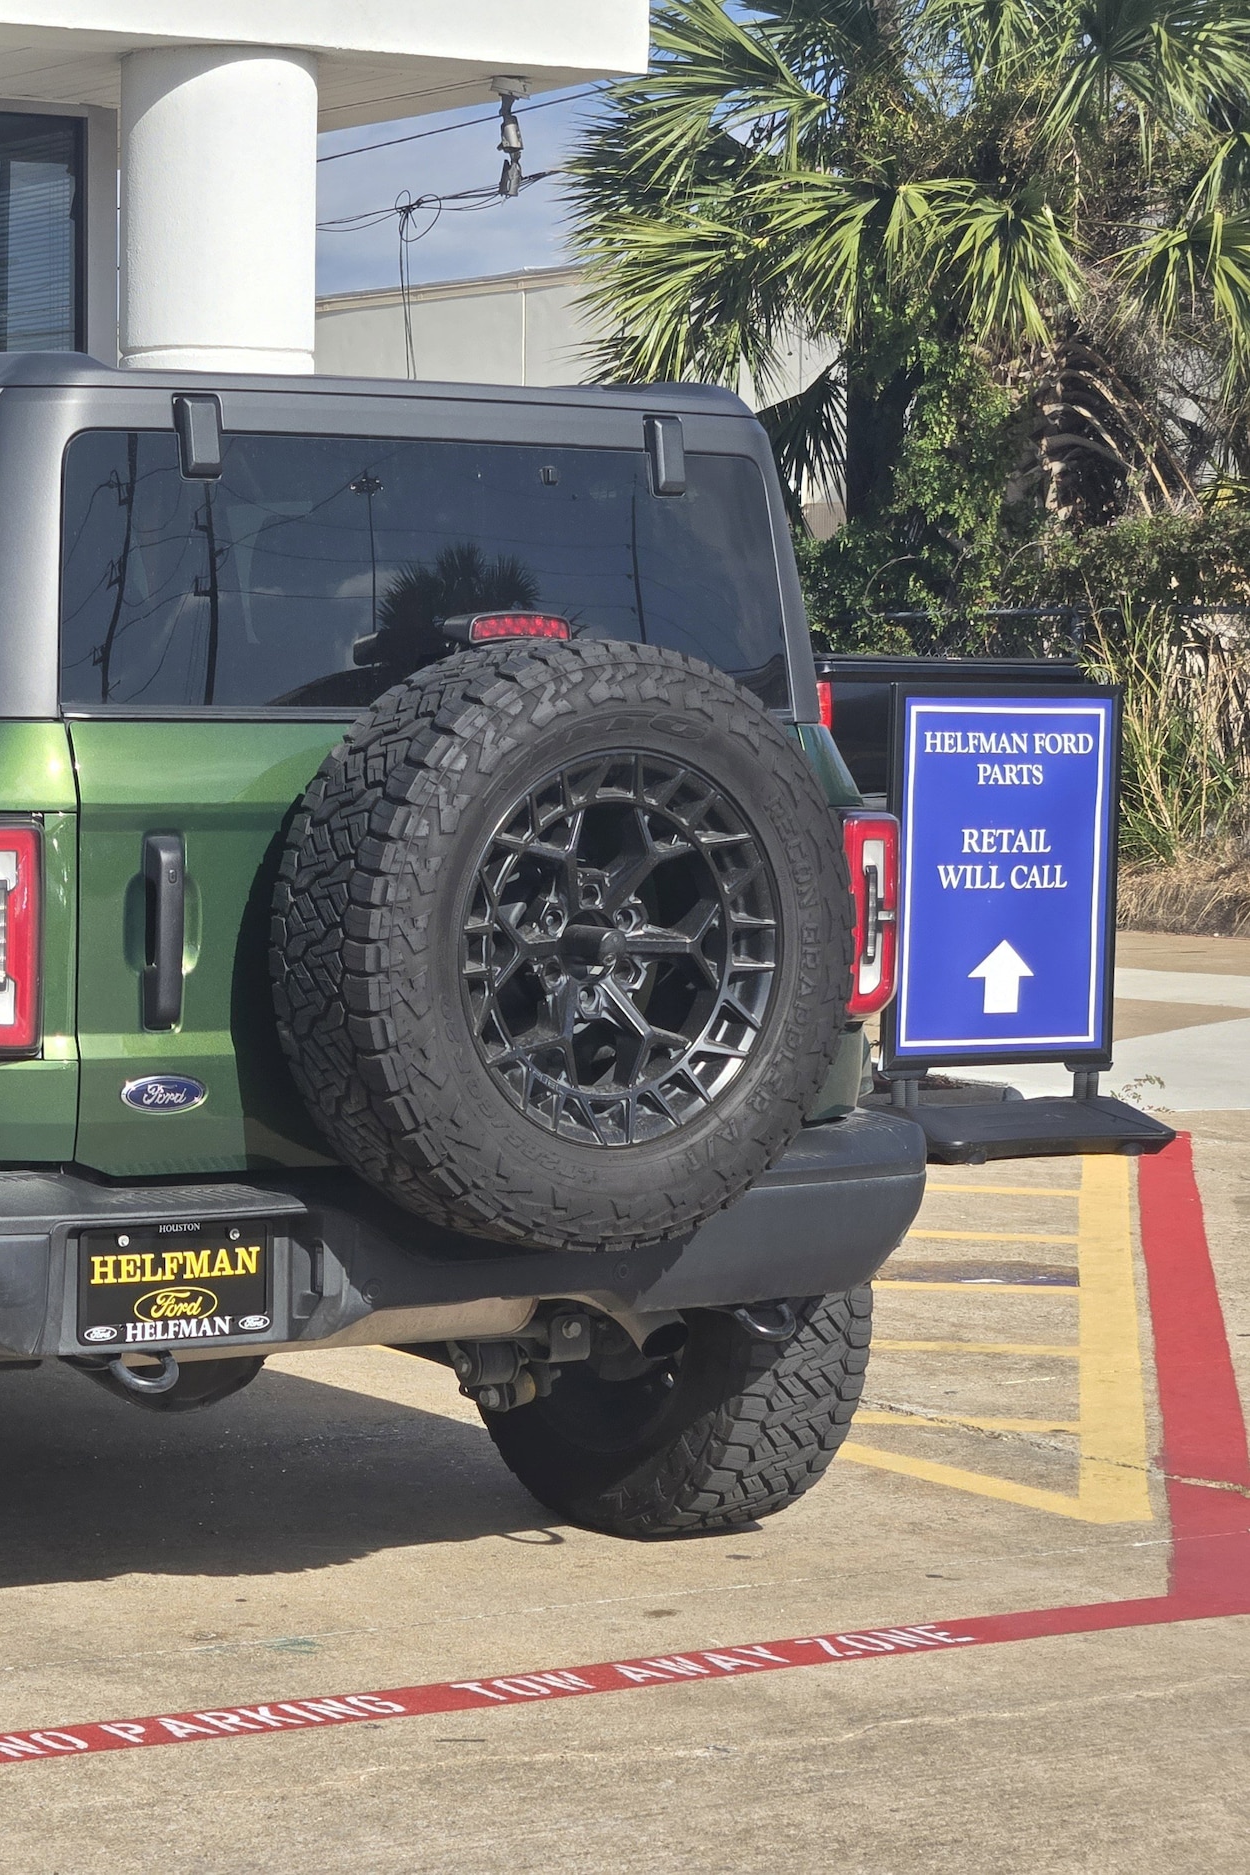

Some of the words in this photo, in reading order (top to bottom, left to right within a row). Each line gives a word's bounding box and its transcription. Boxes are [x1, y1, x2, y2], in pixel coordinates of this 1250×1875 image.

[924, 731, 1029, 754] HELFMAN
[1032, 732, 1094, 755] FORD
[976, 763, 1044, 786] PARTS
[961, 828, 1052, 854] RETAIL
[937, 864, 1005, 890] WILL
[1010, 864, 1068, 890] CALL
[142, 1083, 188, 1106] Ford
[158, 1222, 201, 1234] HOUSTON
[90, 1246, 260, 1285] HELFMAN
[150, 1290, 203, 1319] Ford
[125, 1315, 232, 1343] HELFMAN
[99, 1695, 406, 1743] PARKING
[450, 1671, 597, 1701] TOW
[610, 1645, 791, 1683] AWAY
[794, 1624, 977, 1657] ZONE
